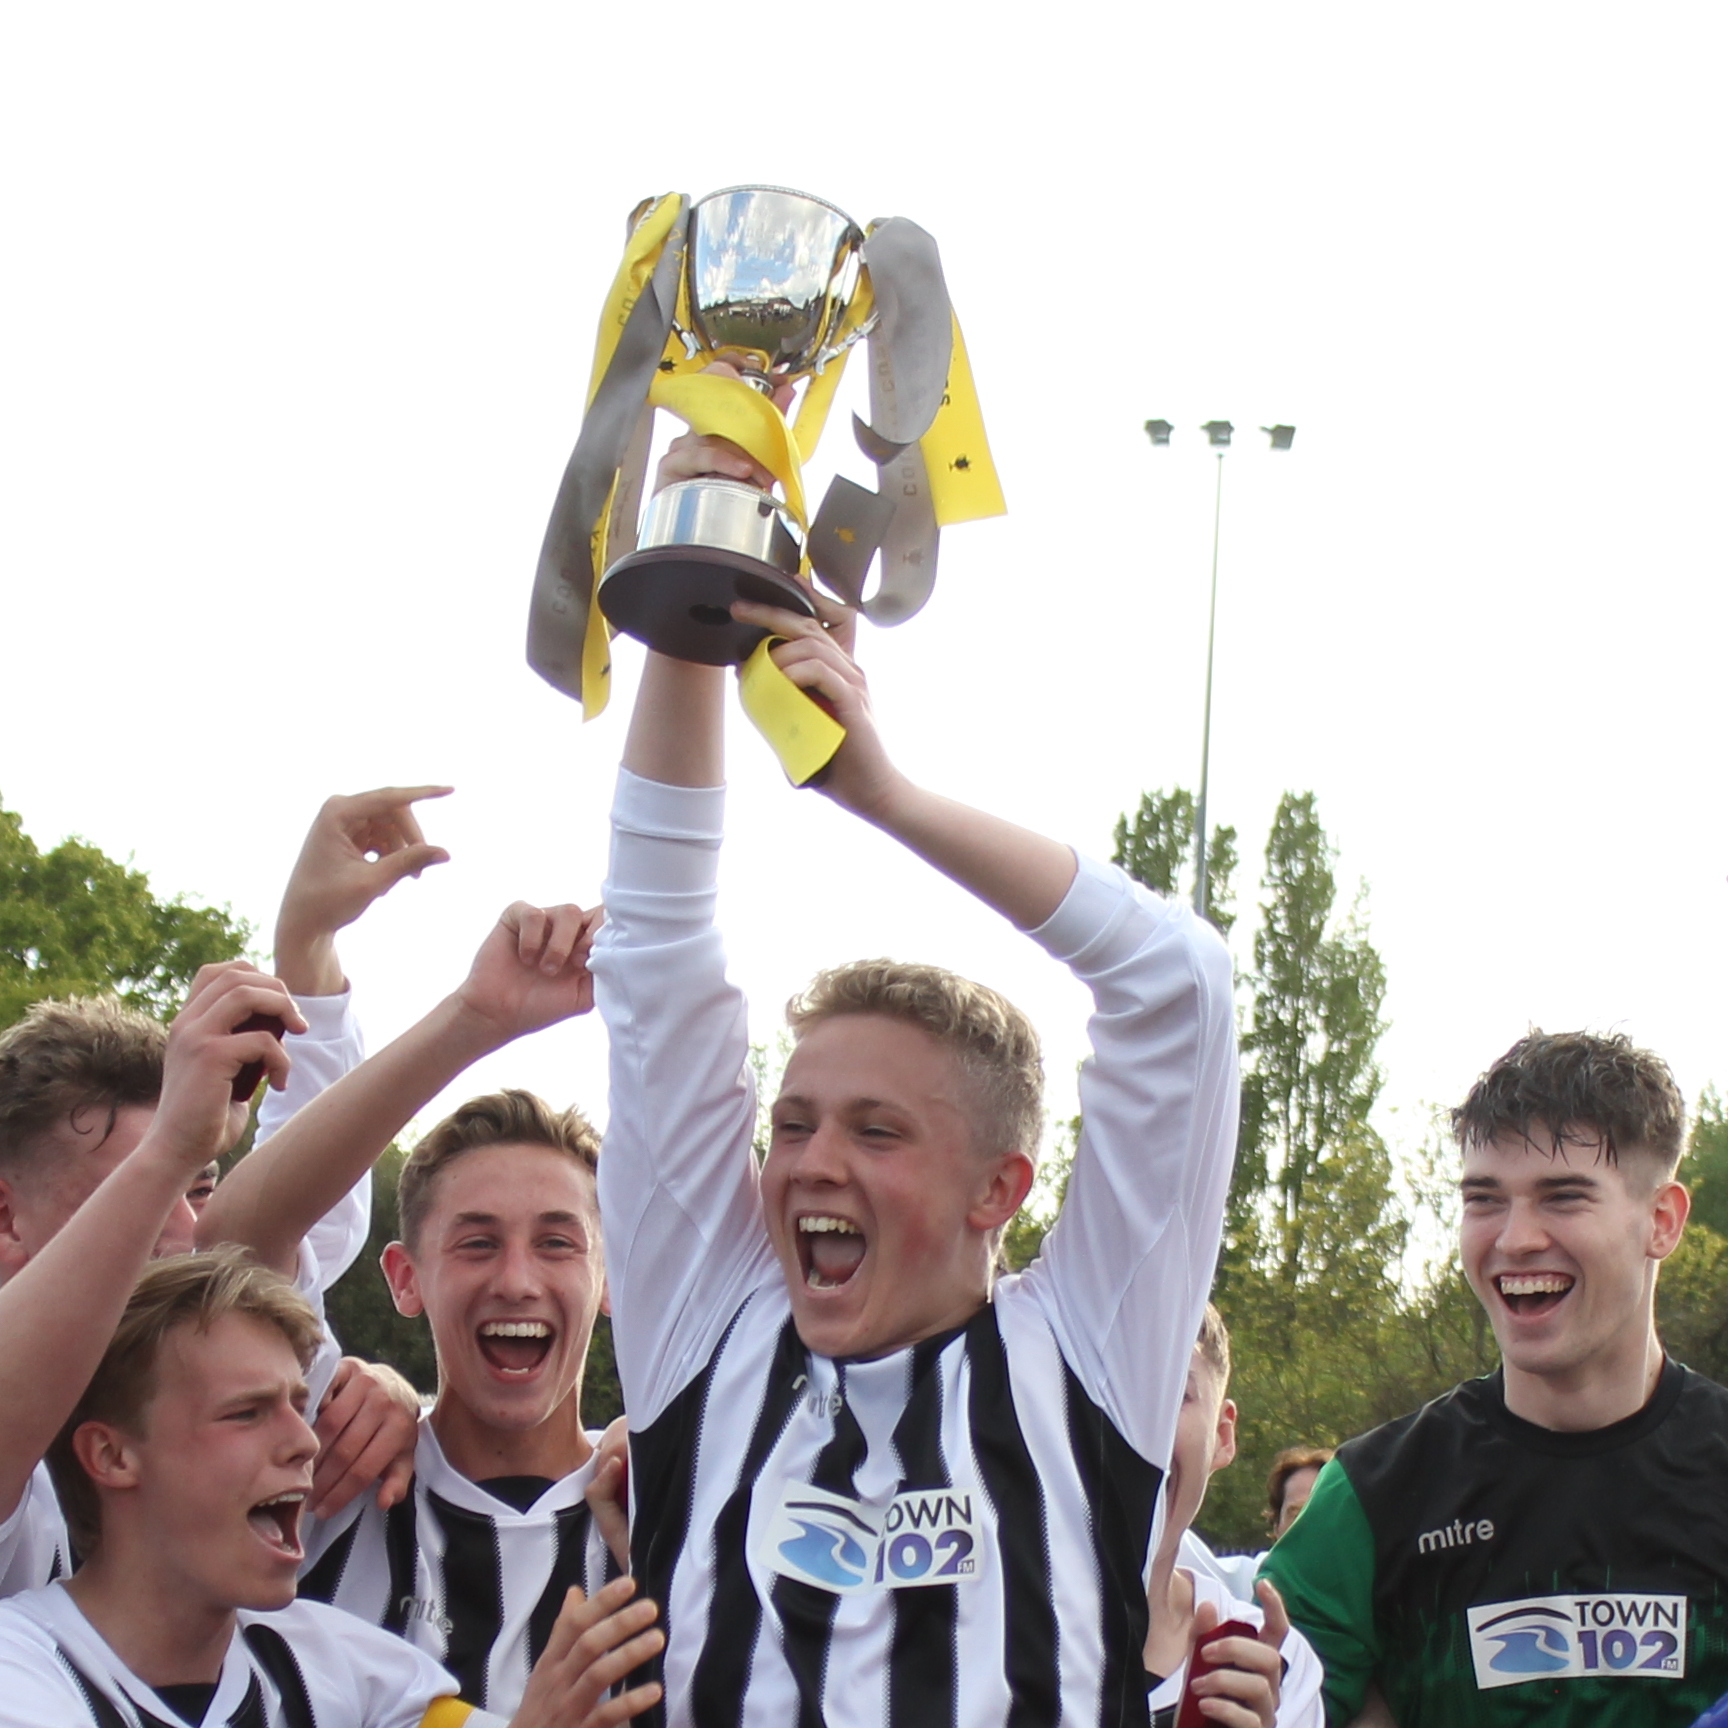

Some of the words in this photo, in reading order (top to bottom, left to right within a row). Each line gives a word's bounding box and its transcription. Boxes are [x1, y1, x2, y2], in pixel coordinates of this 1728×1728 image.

[885, 1495, 972, 1533] OWN
[1417, 1517, 1495, 1555] mitre
[1574, 1600, 1678, 1628] TOWN
[1576, 1629, 1678, 1670] 102
